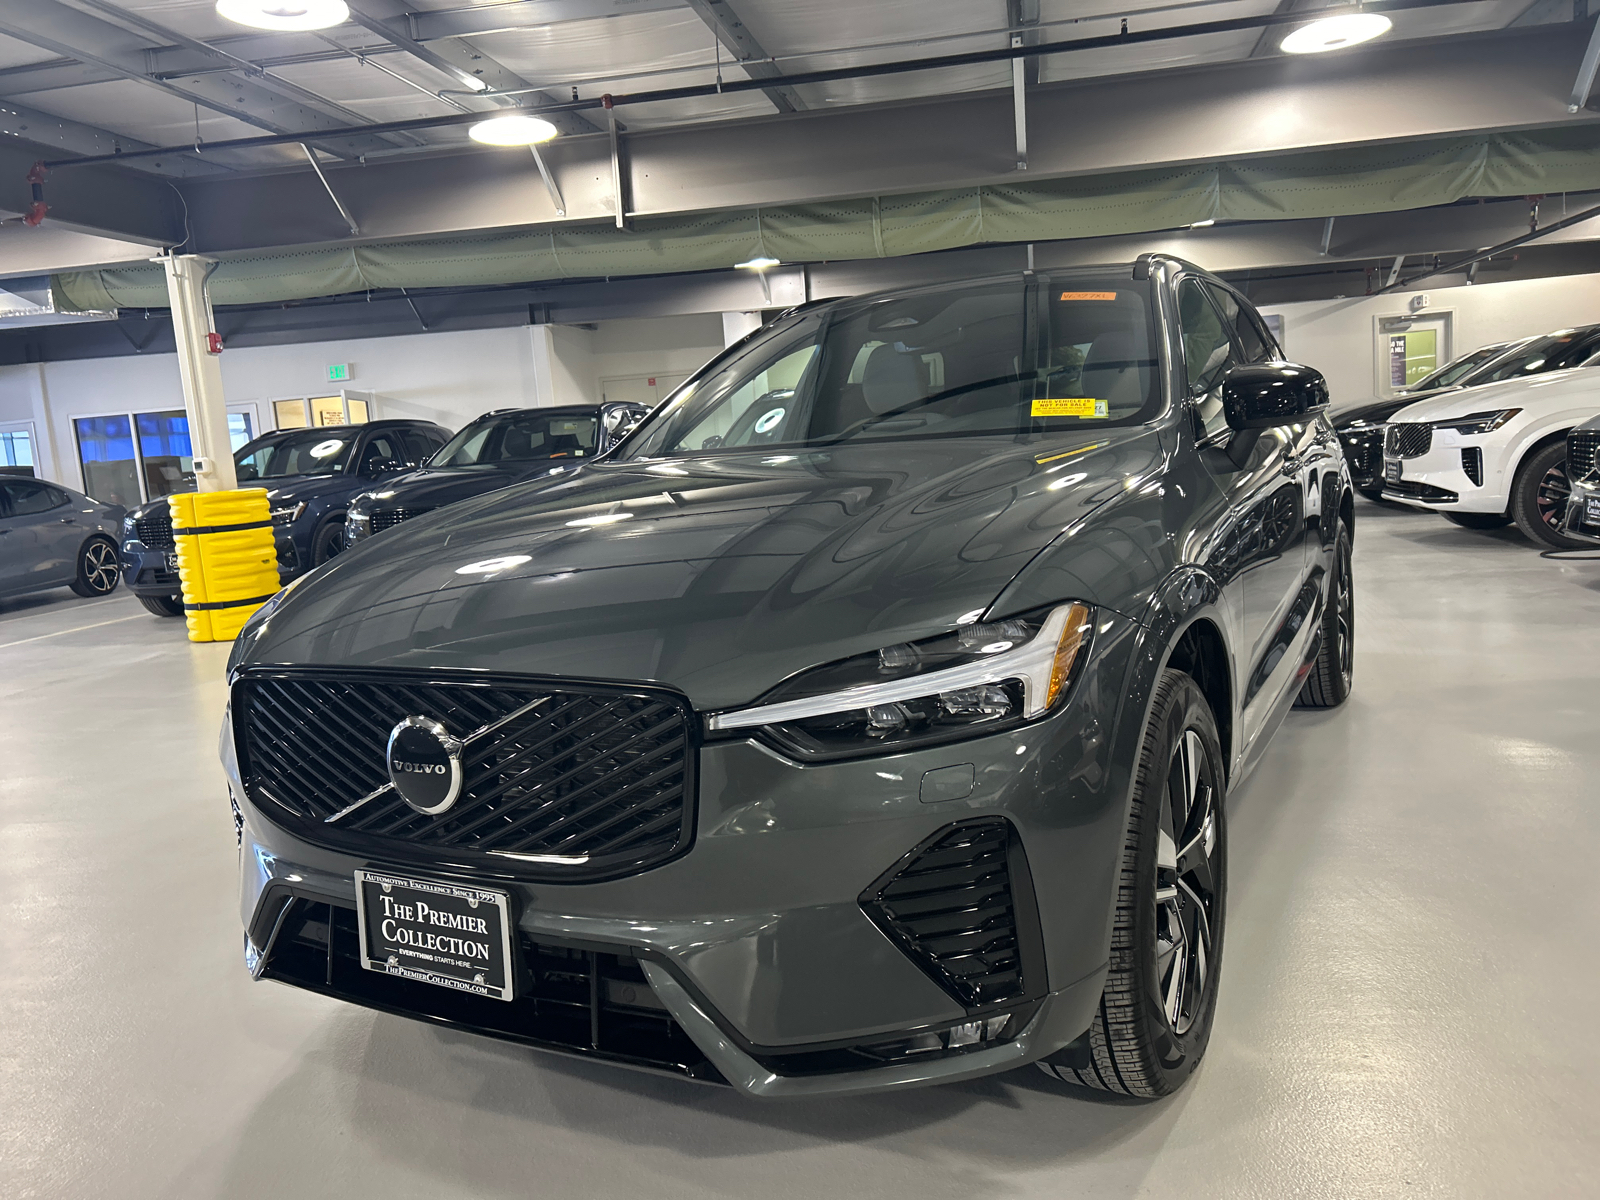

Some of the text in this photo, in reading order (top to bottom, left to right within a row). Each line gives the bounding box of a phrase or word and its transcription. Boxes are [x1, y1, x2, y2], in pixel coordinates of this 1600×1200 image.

[329, 364, 346, 379] EXIT
[393, 760, 446, 775] VOLVO
[366, 873, 495, 902] AUTOMOTIVE EXCELLENCE SINCE 1995
[380, 895, 488, 935] THE PREMIER
[381, 919, 489, 960] COLLECTION
[399, 948, 472, 969] EVERYTHING STARTS HERE.
